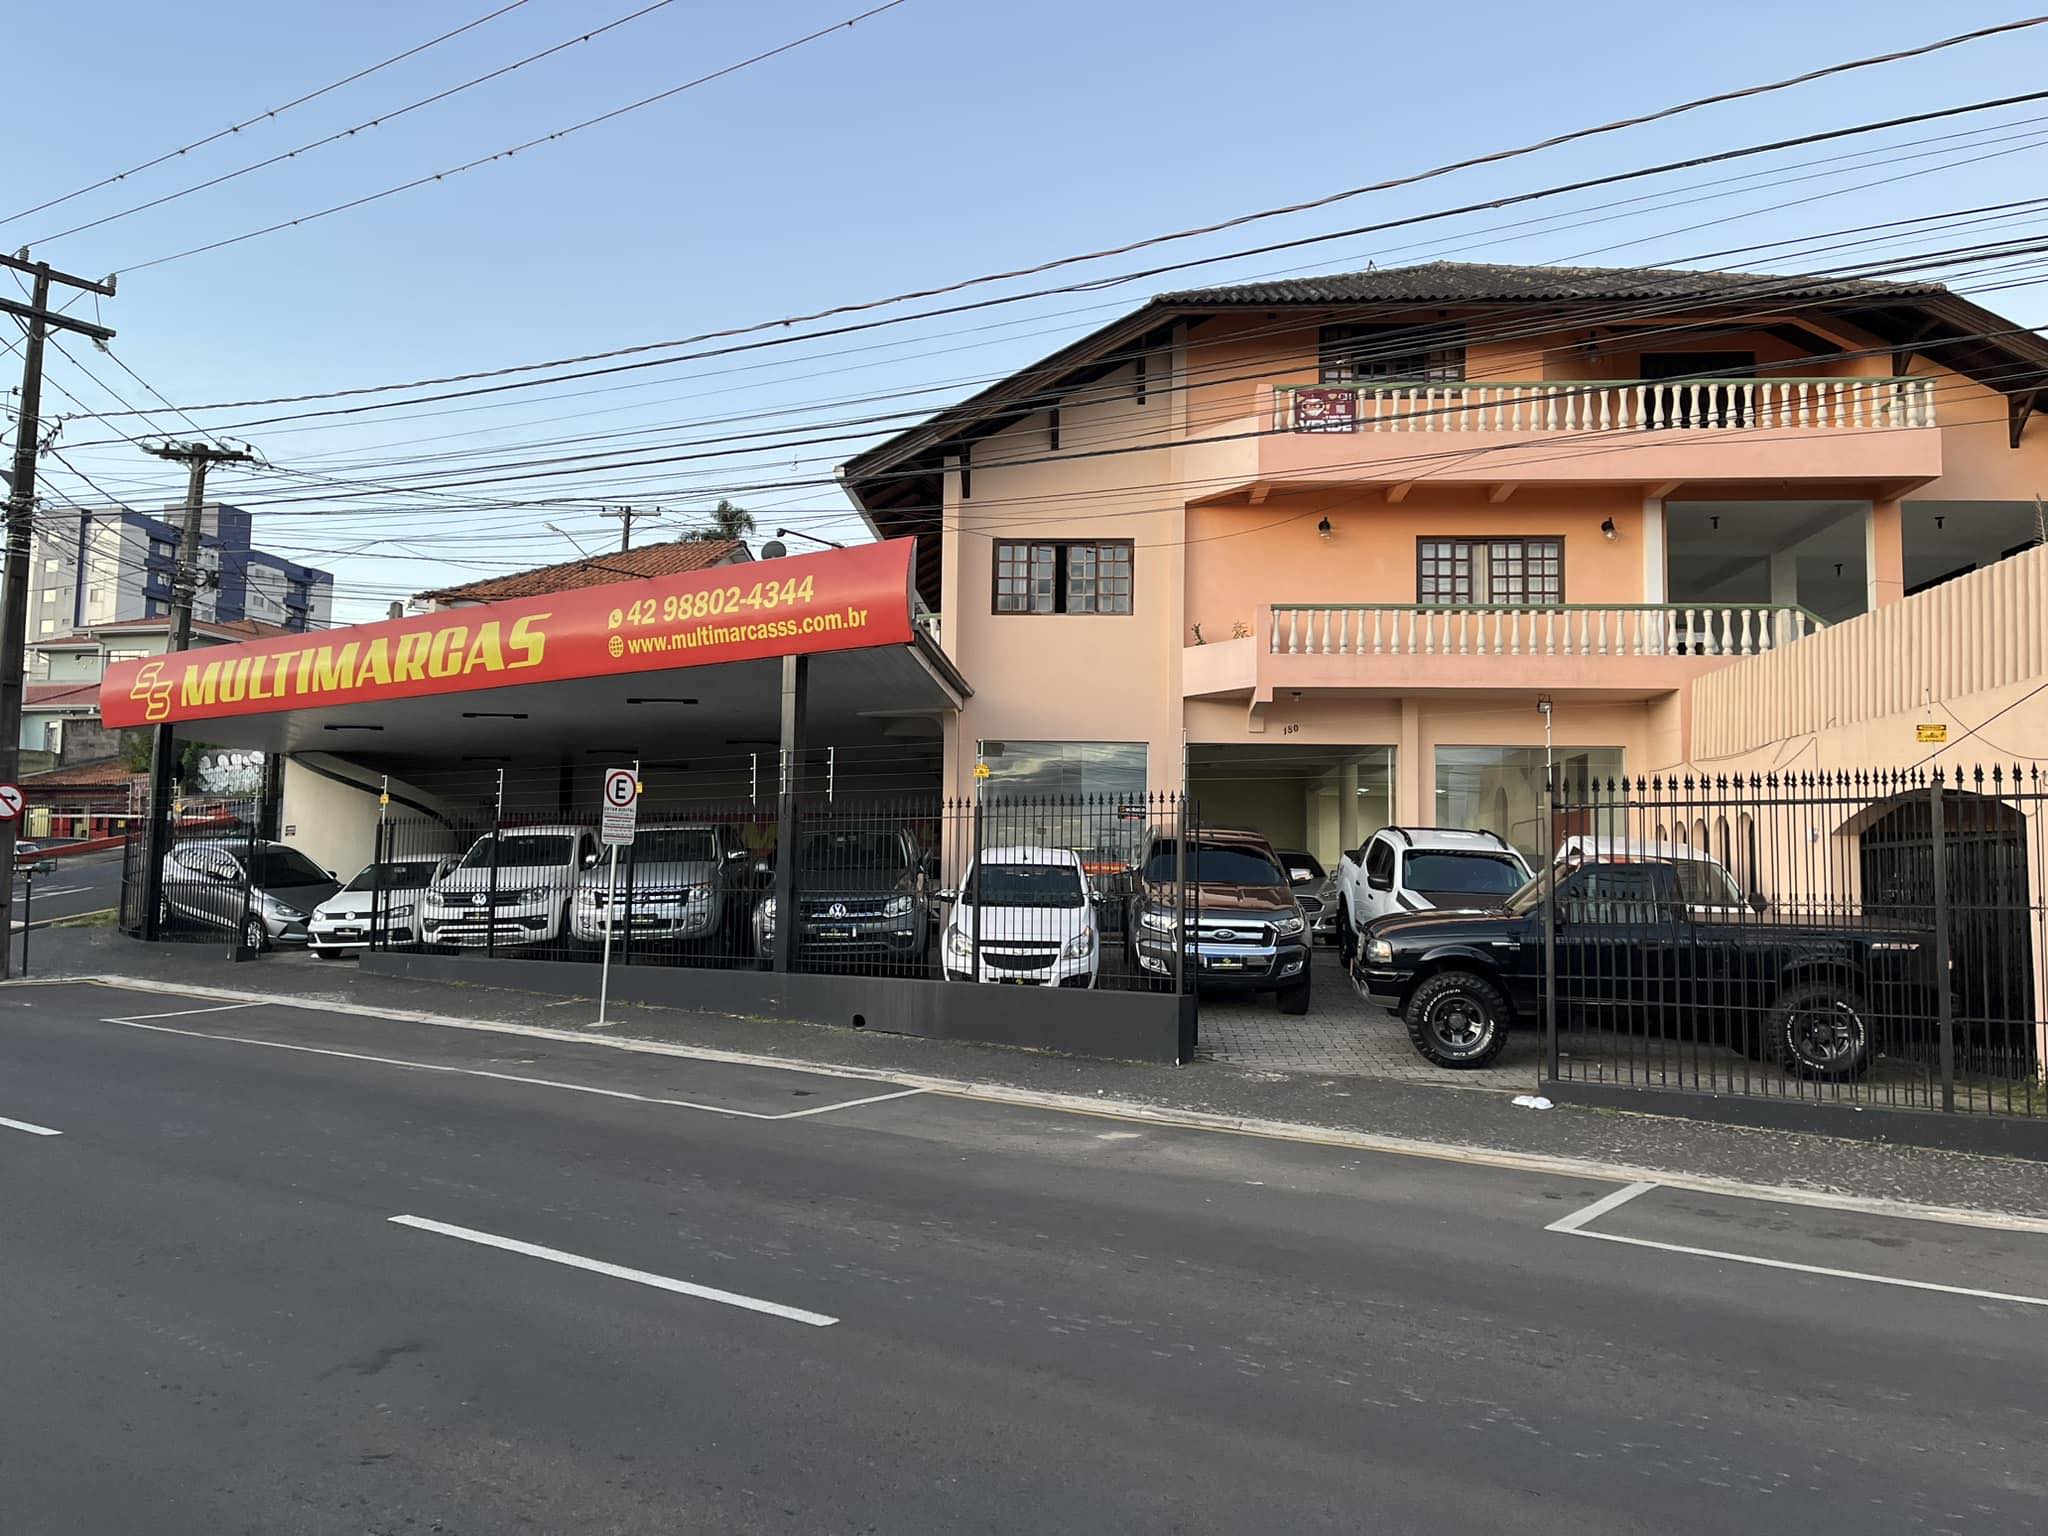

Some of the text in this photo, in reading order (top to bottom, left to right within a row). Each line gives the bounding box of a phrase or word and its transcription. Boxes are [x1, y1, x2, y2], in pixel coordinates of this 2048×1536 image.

[627, 575, 814, 625] 42 98802-4344
[628, 606, 867, 654] www.multimarcasss.com.br
[180, 612, 553, 707] MULTIMARCAS
[1283, 724, 1299, 735] 150
[615, 779, 627, 799] E
